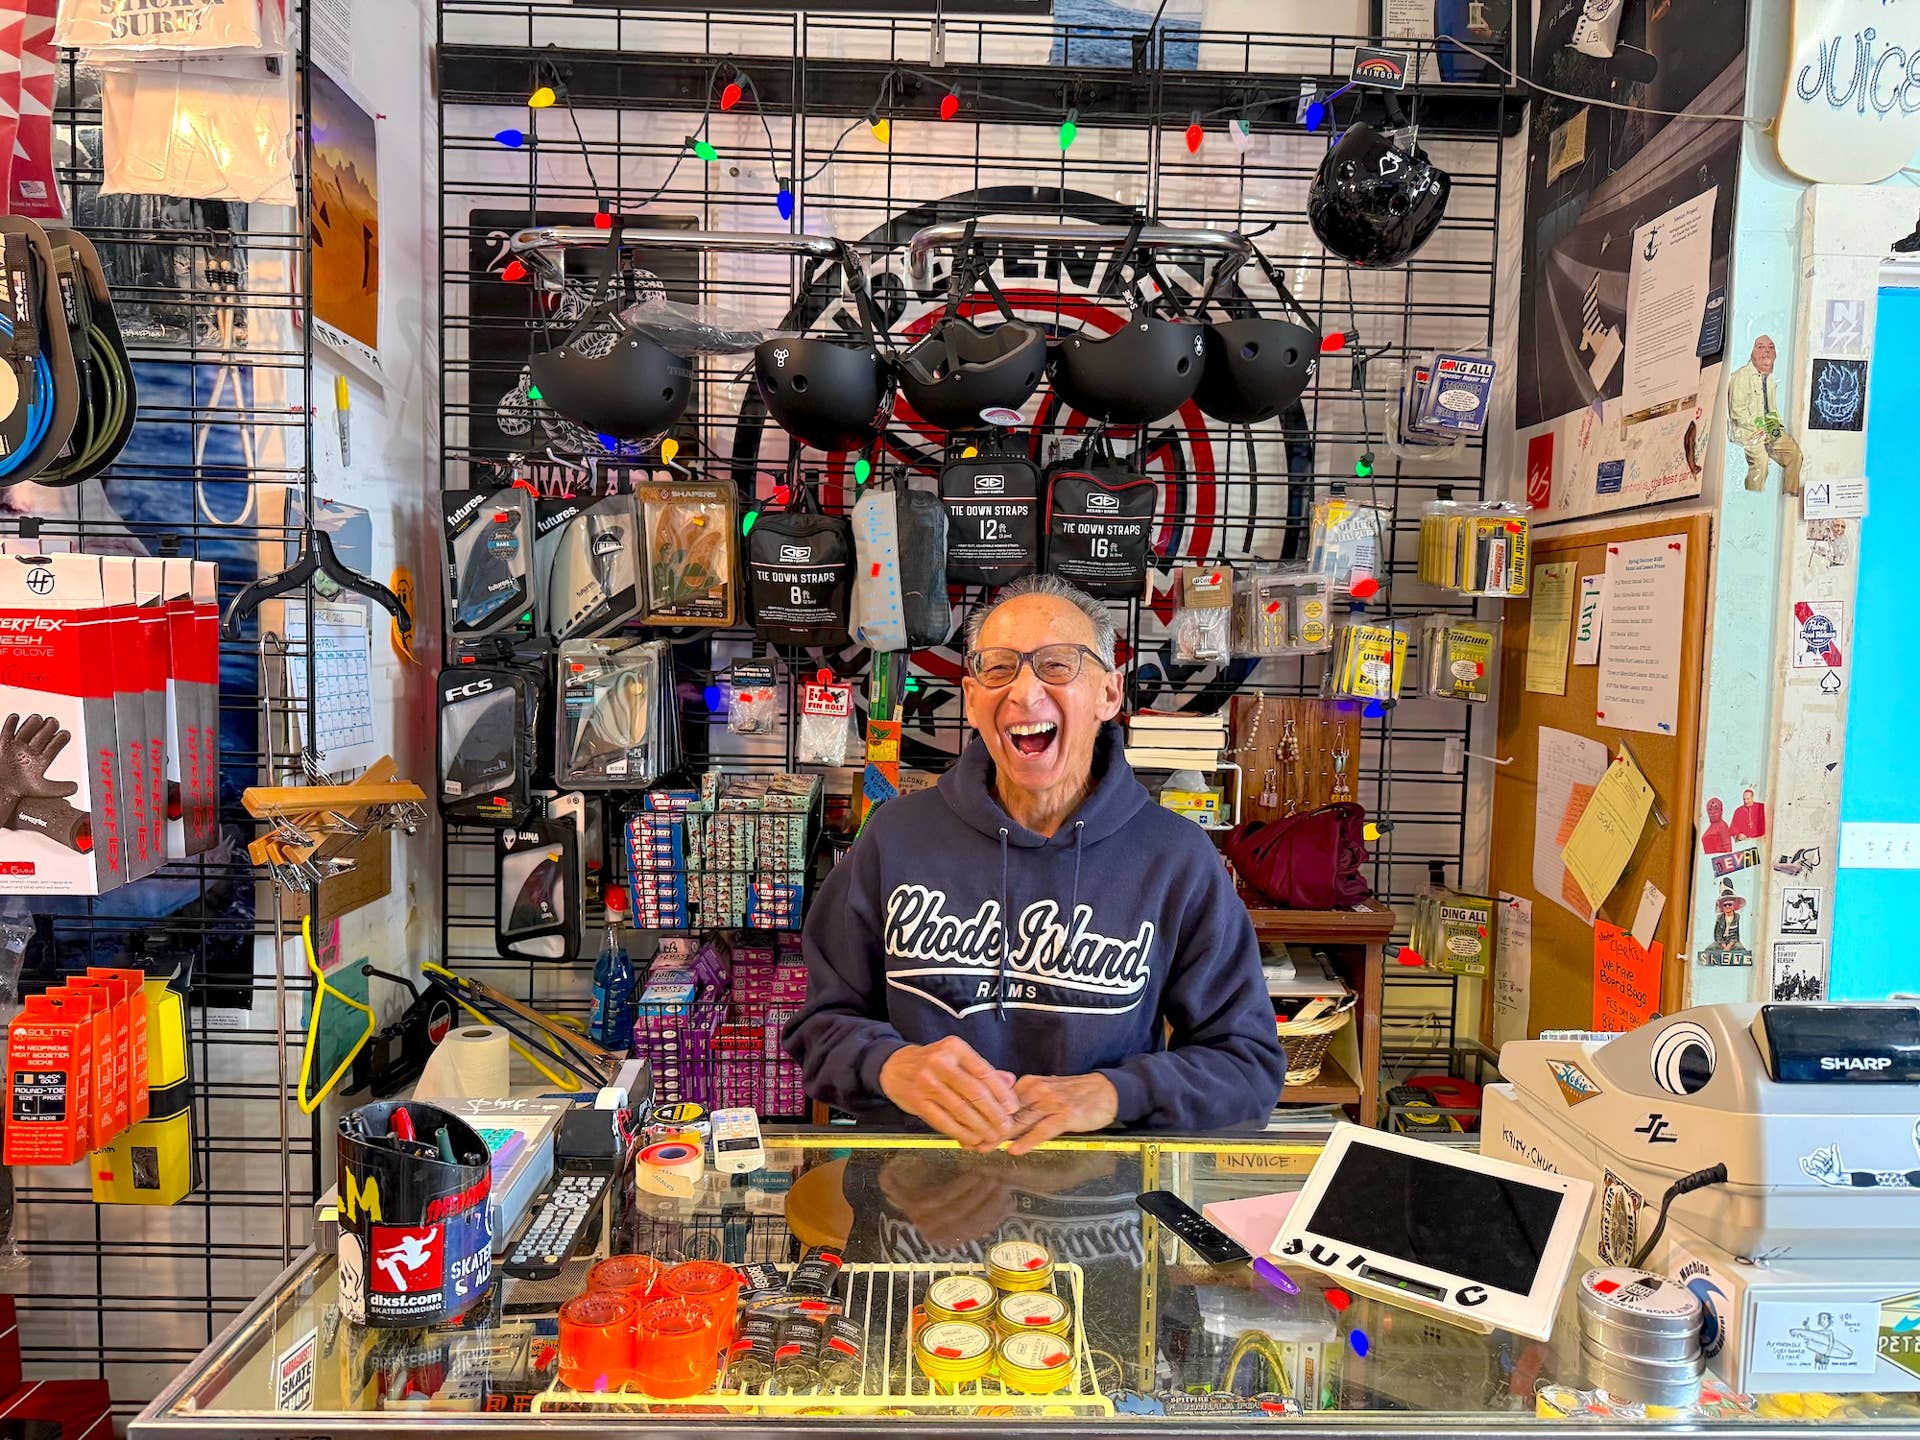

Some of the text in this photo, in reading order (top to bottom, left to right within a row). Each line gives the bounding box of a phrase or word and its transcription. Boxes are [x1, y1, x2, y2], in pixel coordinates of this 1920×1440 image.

[1357, 66, 1401, 81] RAINBOW
[1470, 364, 1490, 376] ALL
[951, 505, 1028, 516] TIE DOWN STRAPS
[537, 507, 580, 533] futures.
[979, 520, 997, 540] 12
[1063, 522, 1140, 536] TIE DOWN STRAPS
[1091, 538, 1108, 558] 16
[757, 571, 835, 583] TIE DOWN STRAPS
[790, 586, 802, 605] 8
[0, 615, 62, 632] ERFLEX
[316, 637, 339, 650] APRIL
[13, 648, 54, 657] GLOVE
[445, 678, 493, 702] FCS
[1455, 679, 1476, 690] ALL
[808, 702, 844, 711] FIN BOLT
[670, 799, 690, 807] STICKY
[519, 831, 539, 842] LUNA
[1442, 908, 1486, 922] DING ALL
[884, 884, 1154, 987] Rhode Island
[976, 981, 1037, 998] RAMS
[27, 1028, 69, 1038] SOLITE
[27, 1044, 69, 1052] NEOPRENE
[1820, 1056, 1892, 1072] SHARP
[14, 1087, 66, 1095] ROUND-TOE
[22, 1102, 32, 1112] L
[1226, 1154, 1291, 1169] INVOICE
[370, 1292, 443, 1307] dlxsf.com
[371, 1305, 442, 1315] SKATEBOARDING
[282, 1361, 313, 1399] SKATE
[1170, 1396, 1209, 1404] SPITFIRE
